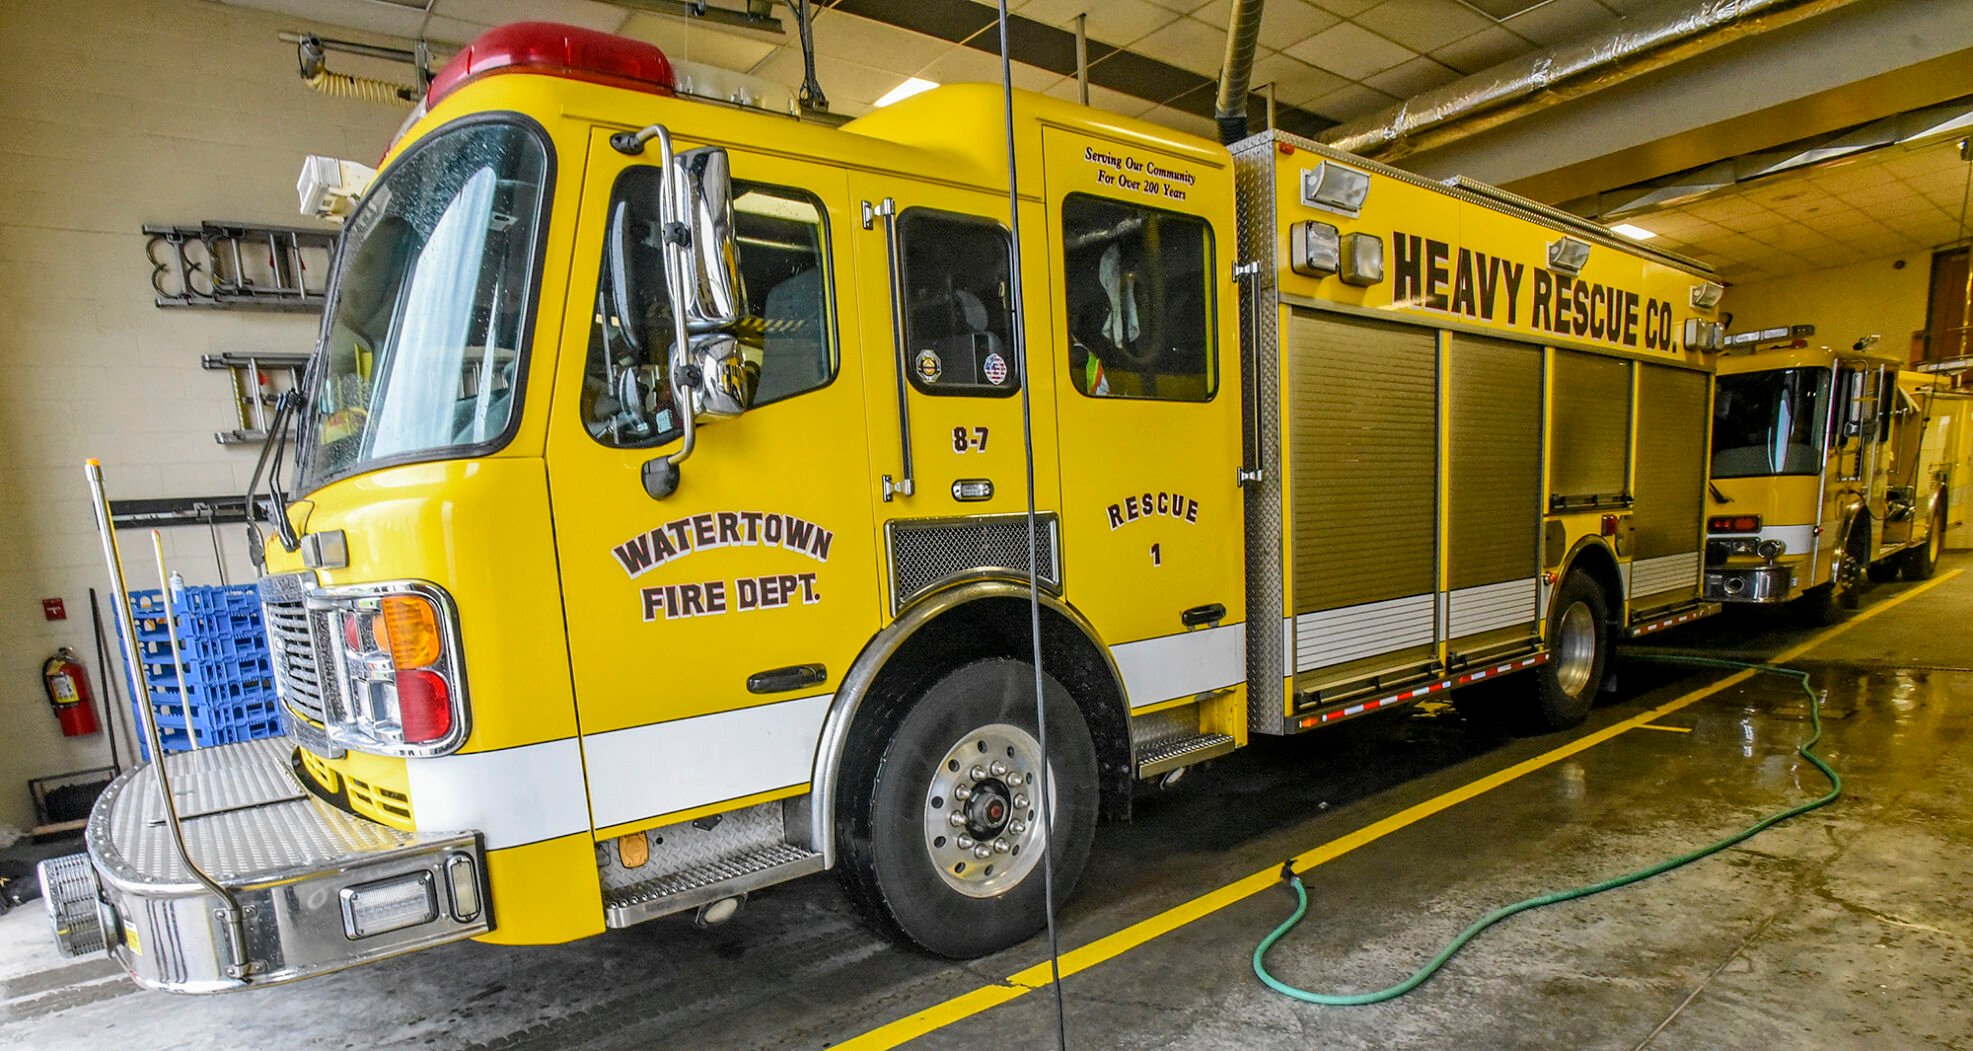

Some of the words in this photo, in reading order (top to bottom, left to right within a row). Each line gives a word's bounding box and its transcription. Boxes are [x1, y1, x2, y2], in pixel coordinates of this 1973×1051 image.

[1085, 147, 1122, 169] Serving
[1125, 157, 1143, 171] Our
[1146, 161, 1196, 186] Community
[1097, 170, 1115, 184] For
[1118, 174, 1140, 190] Over
[1143, 180, 1159, 194] 200
[1163, 184, 1186, 200] Years
[1392, 231, 1524, 327] HEAVY
[1531, 267, 1639, 347] RESCUE
[1644, 298, 1677, 354] CO.
[952, 426, 989, 454] 8-7
[1106, 491, 1198, 531] RESCUE
[611, 511, 834, 579] WATERTOWN
[1150, 543, 1160, 567] 1
[641, 580, 726, 622] FIRE
[736, 572, 820, 612] DEPT.
